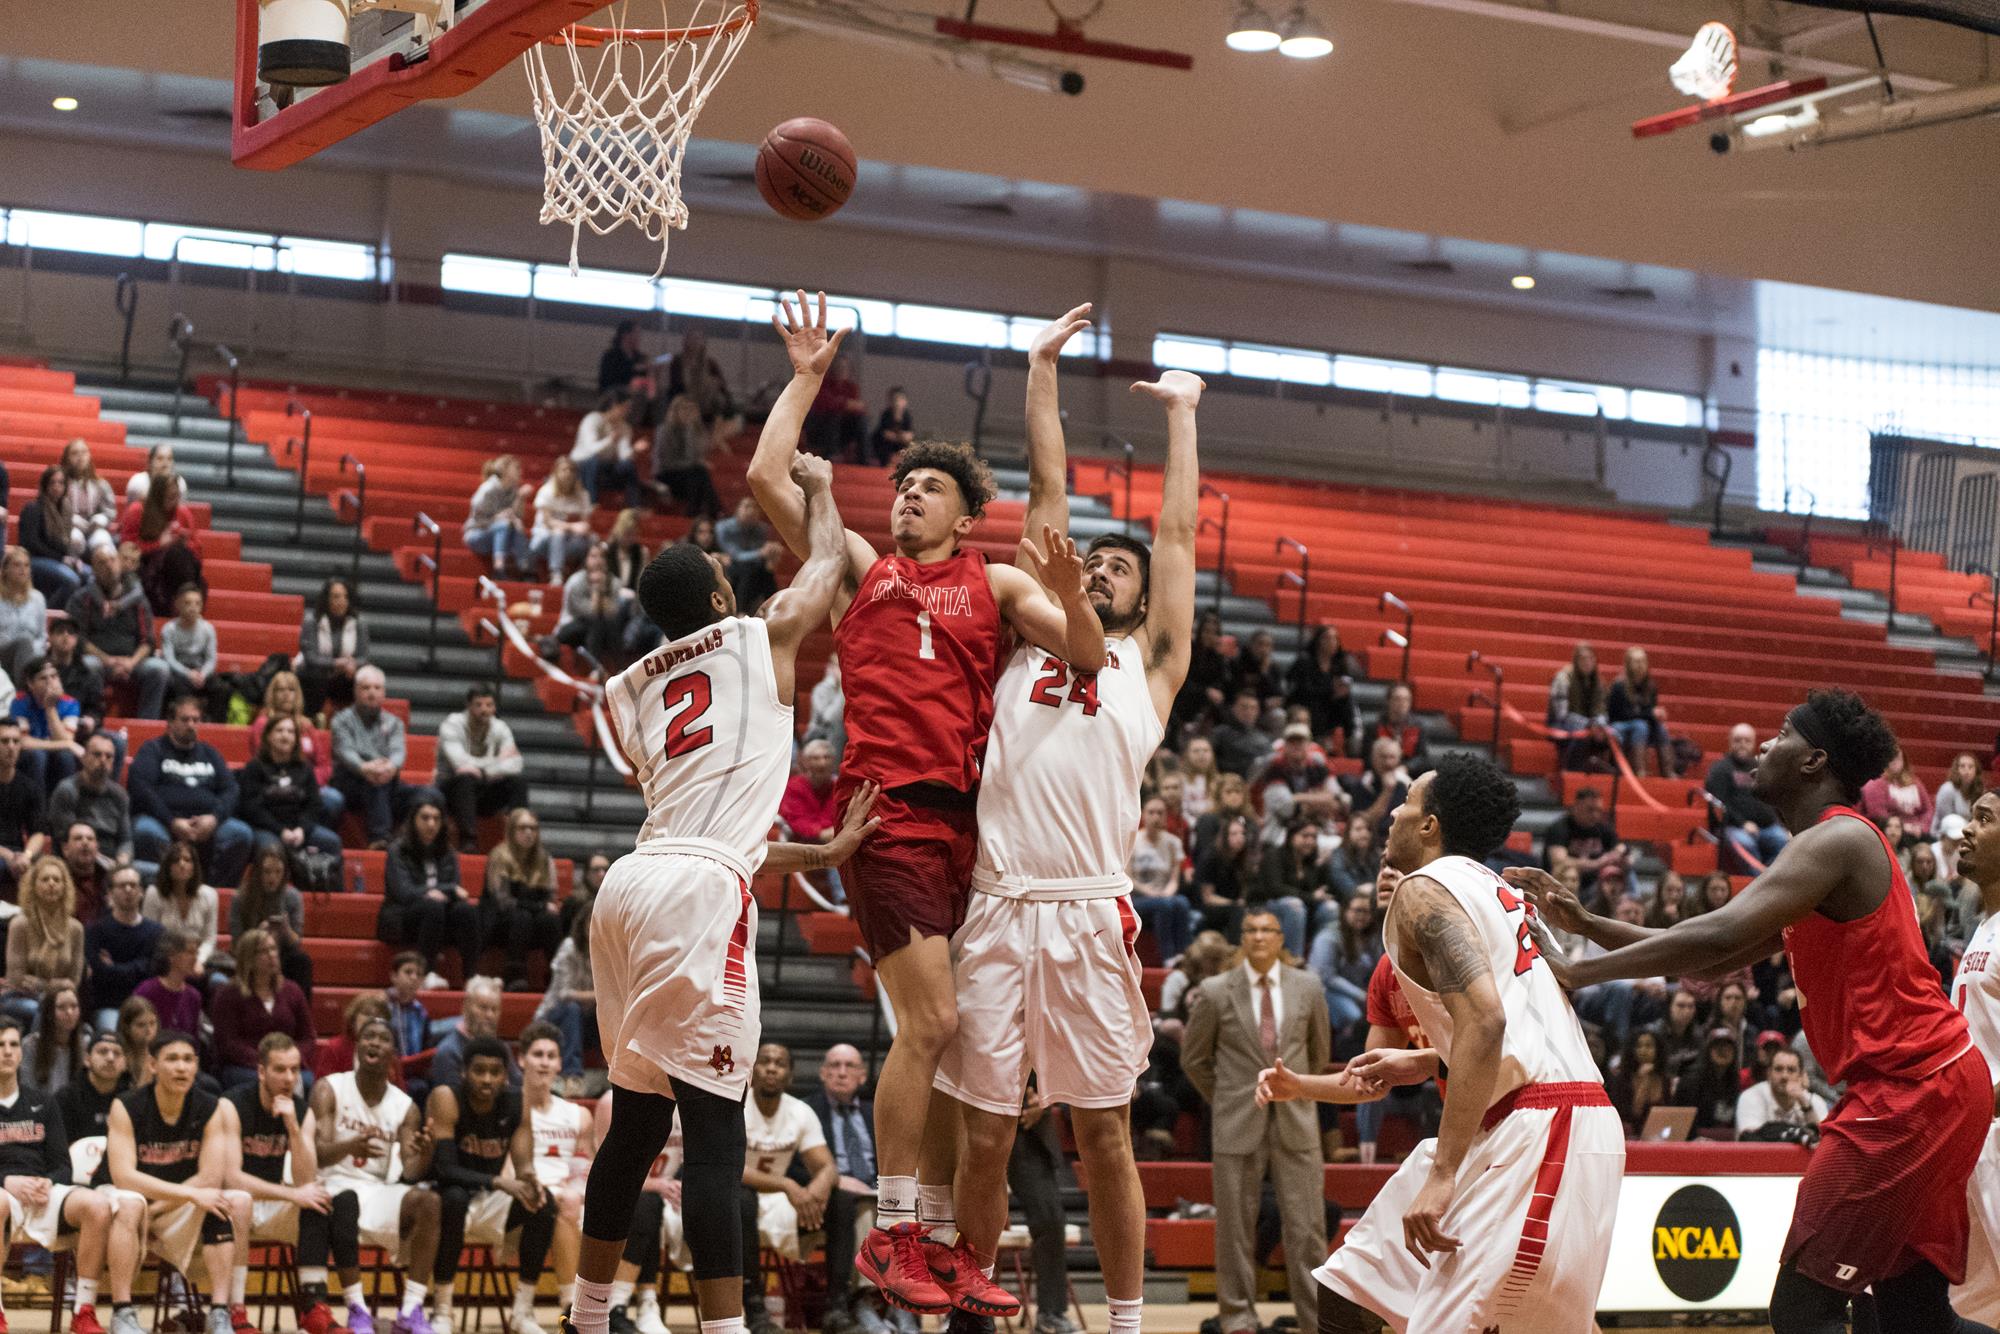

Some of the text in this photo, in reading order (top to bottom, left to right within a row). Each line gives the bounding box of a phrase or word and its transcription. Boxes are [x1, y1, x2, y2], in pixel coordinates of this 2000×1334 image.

[799, 147, 851, 193] Wilson
[643, 628, 723, 677] CARDNALS
[917, 611, 935, 660] 1
[1029, 656, 1102, 717] 24
[662, 670, 713, 761] 2
[1655, 1226, 1742, 1260] NCAA
